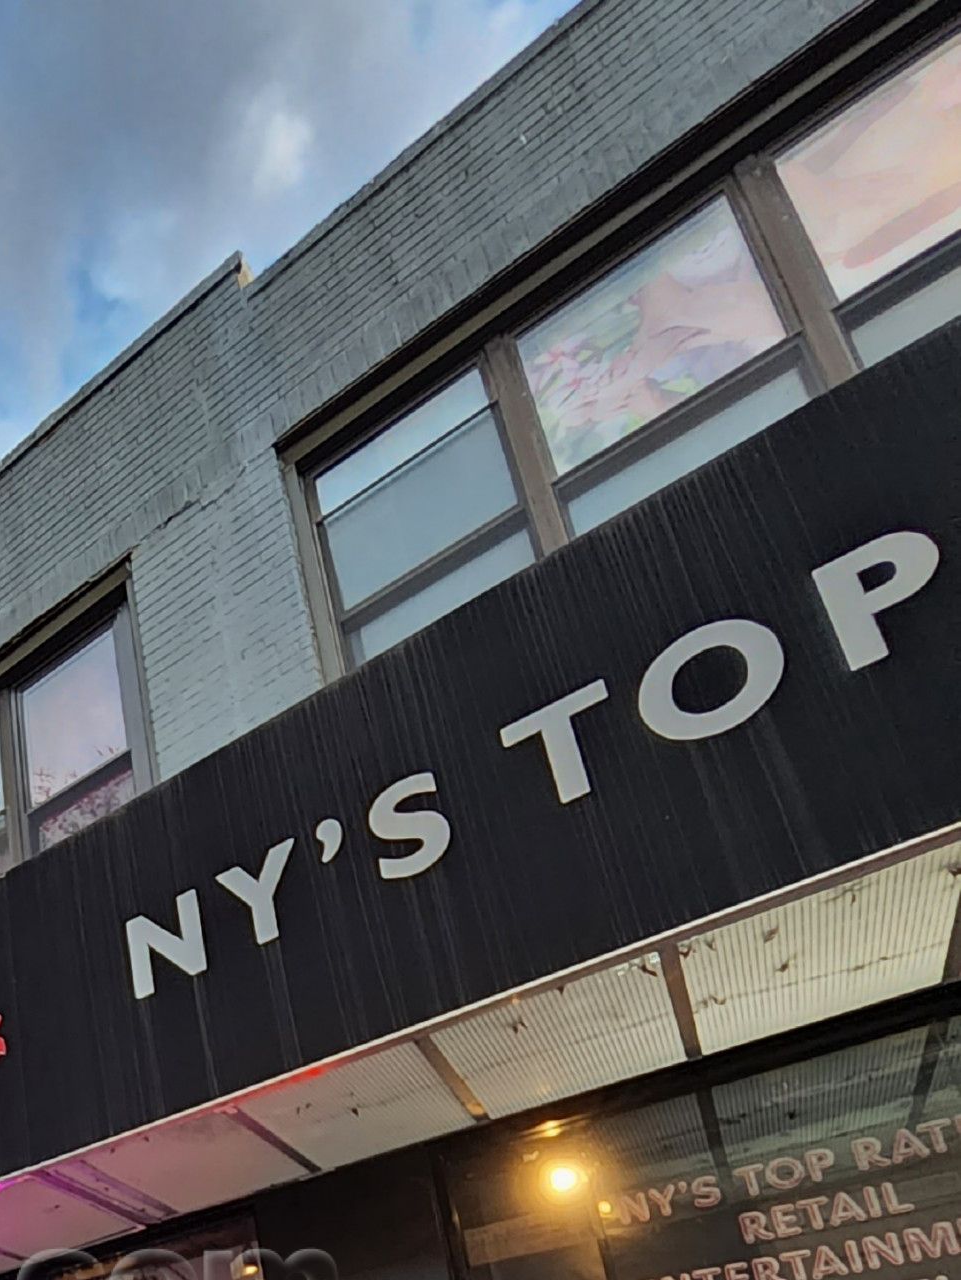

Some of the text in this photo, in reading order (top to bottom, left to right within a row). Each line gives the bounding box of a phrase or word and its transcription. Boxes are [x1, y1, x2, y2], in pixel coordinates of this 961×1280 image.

[125, 530, 940, 999] NY'S TOP
[733, 1148, 835, 1197] TOP
[851, 1113, 961, 1172] RAT
[739, 1182, 916, 1245] RETAIL
